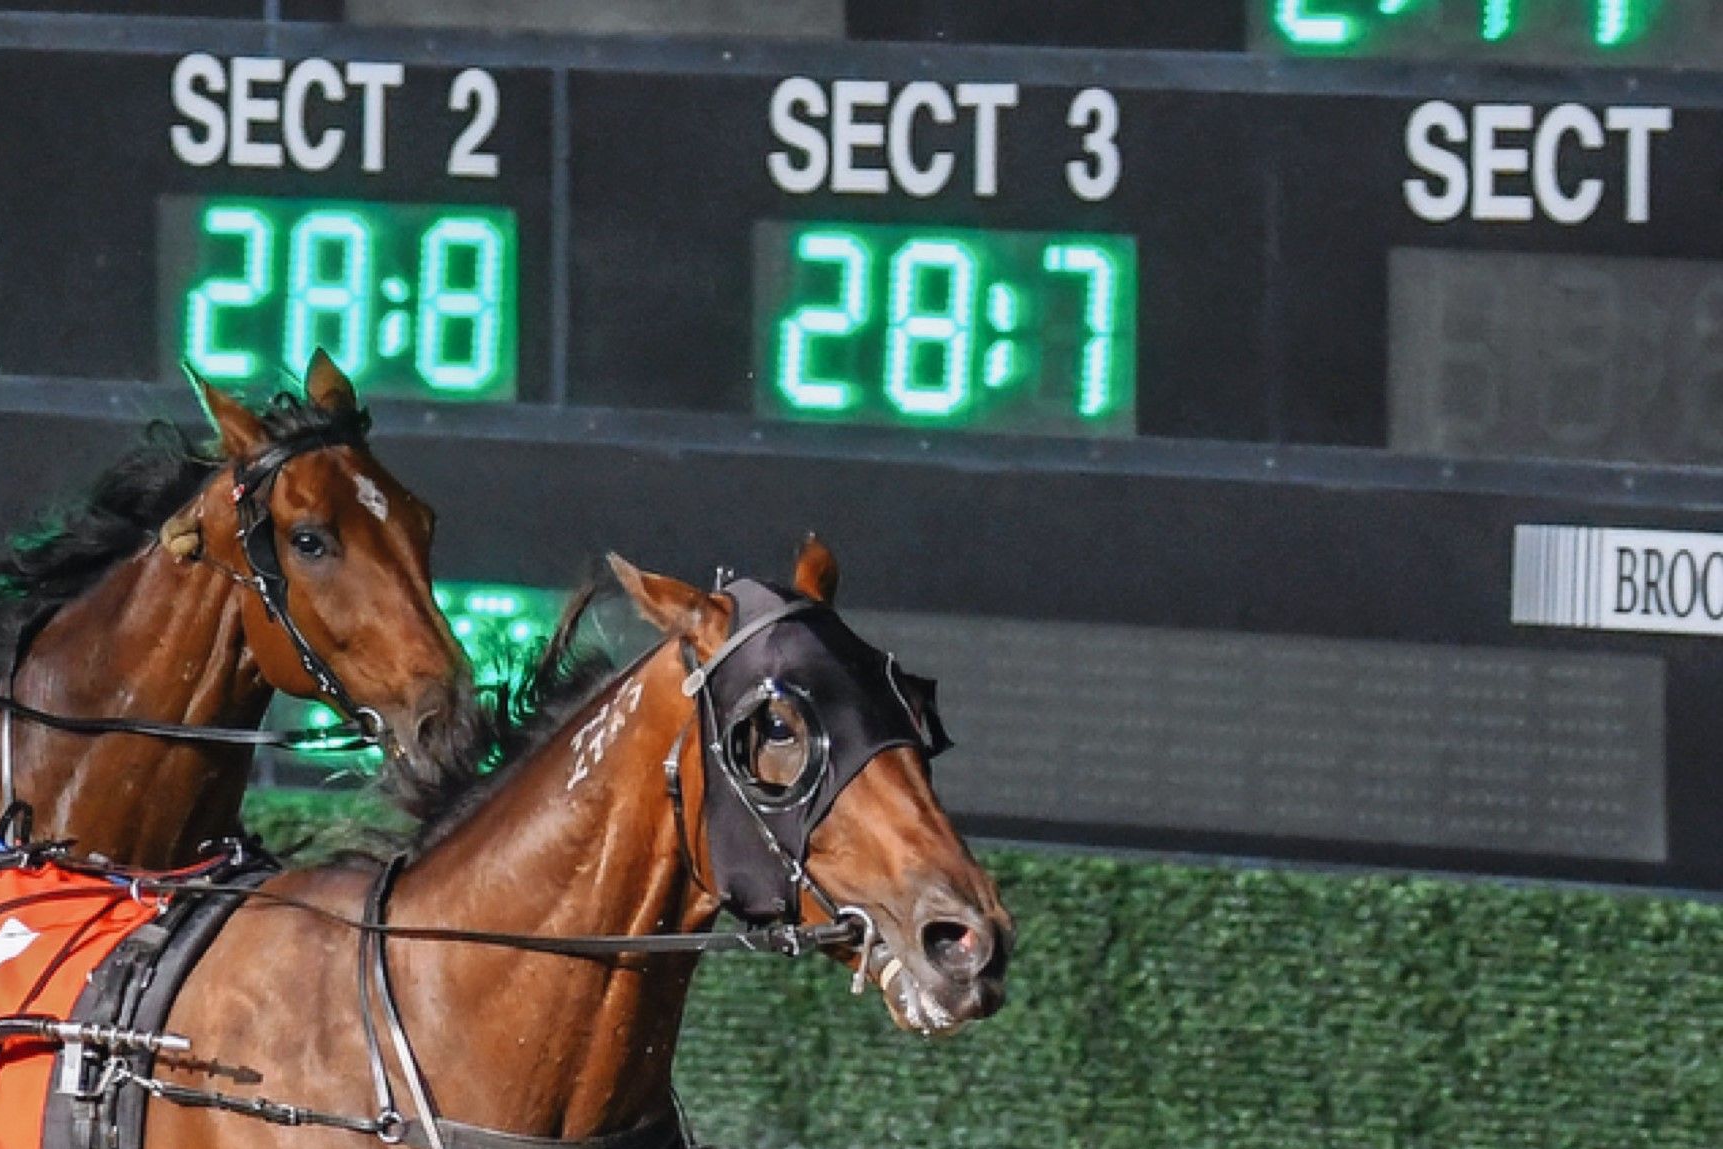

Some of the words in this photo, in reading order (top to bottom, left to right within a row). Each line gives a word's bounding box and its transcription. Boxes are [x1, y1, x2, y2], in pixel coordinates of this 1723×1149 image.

[171, 54, 403, 171] SECT
[448, 68, 498, 176] 2
[768, 77, 1018, 196] SECT
[1066, 88, 1120, 199] 3
[1403, 100, 1672, 223] SECT
[182, 207, 505, 391] 28:8
[776, 231, 1120, 416] 28:7
